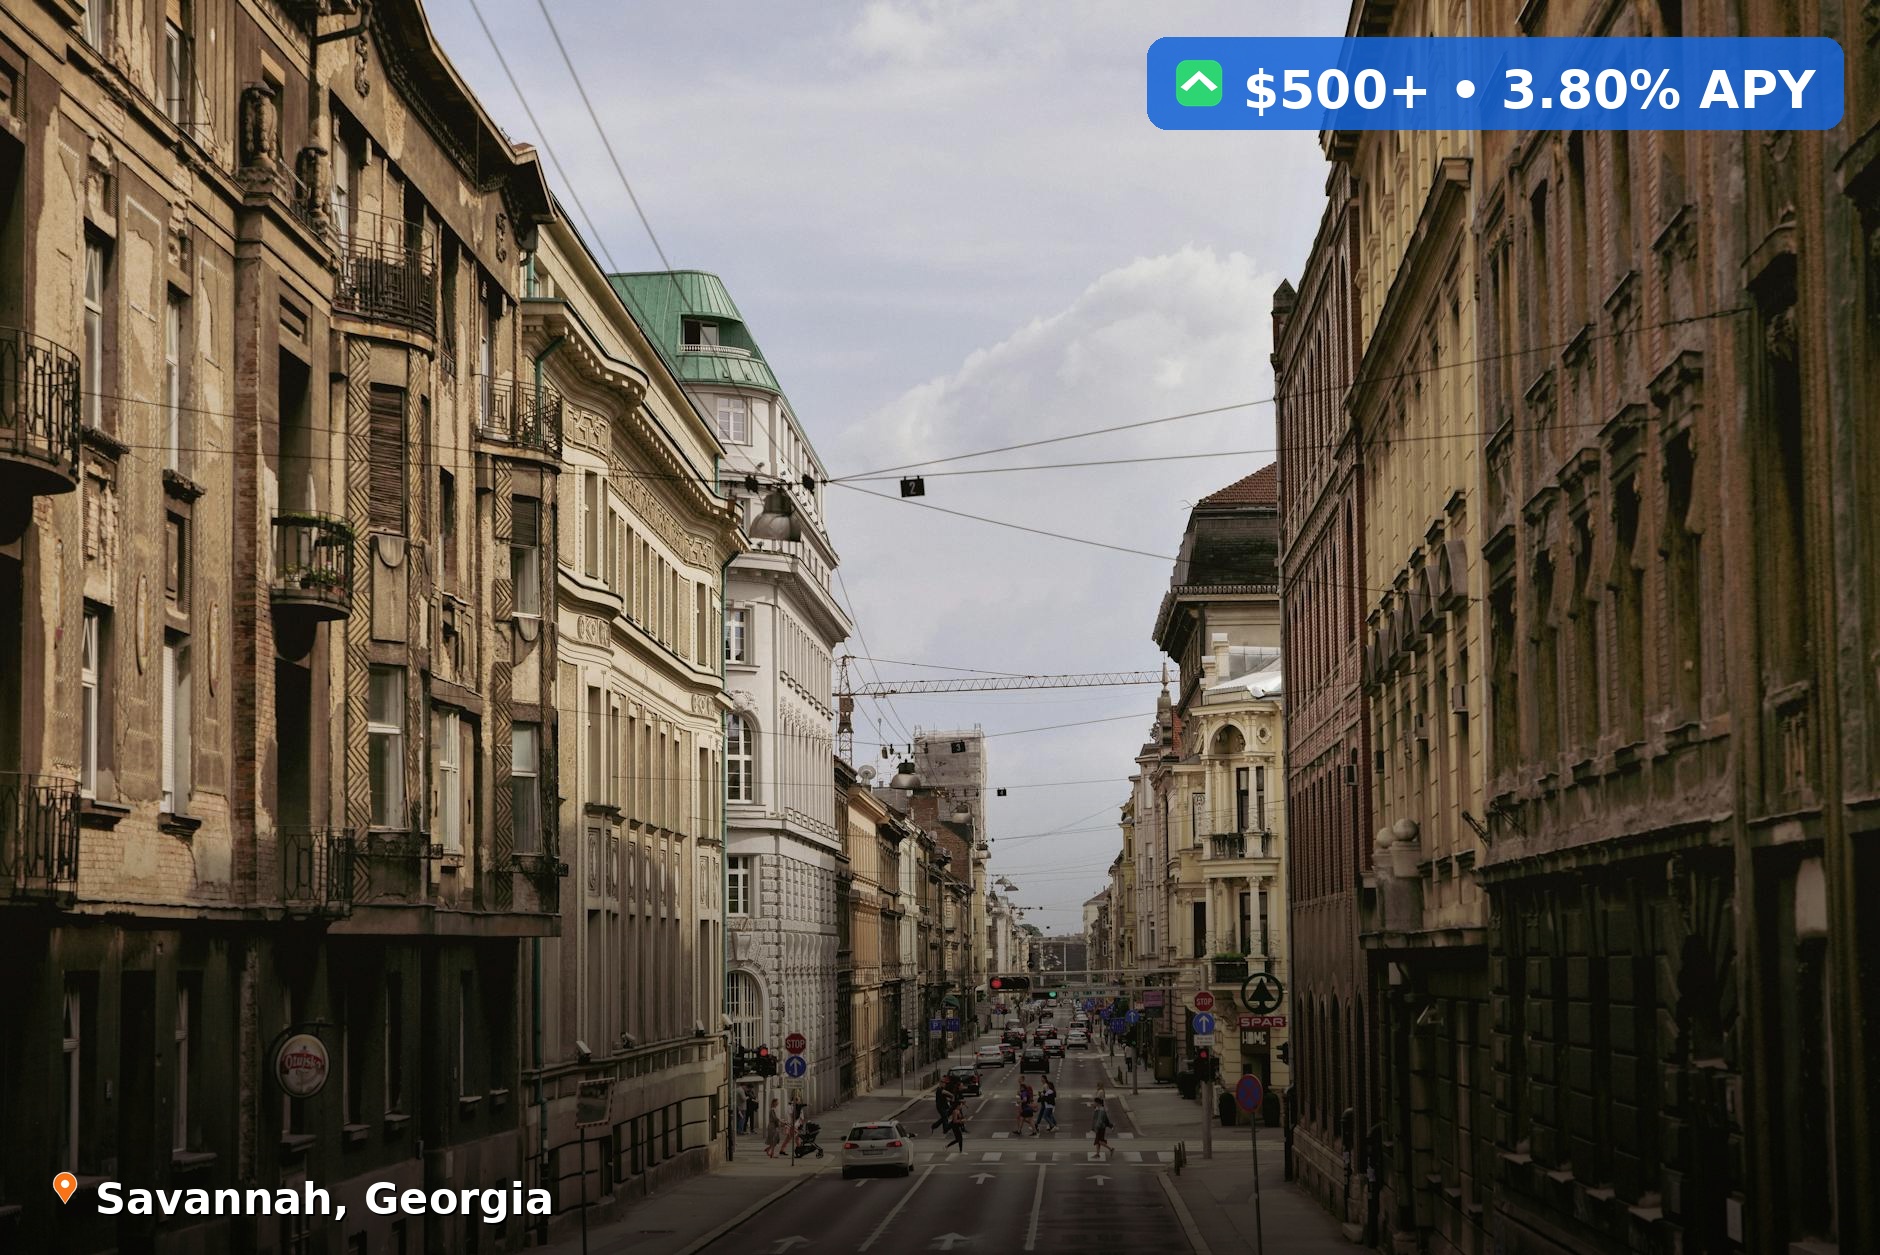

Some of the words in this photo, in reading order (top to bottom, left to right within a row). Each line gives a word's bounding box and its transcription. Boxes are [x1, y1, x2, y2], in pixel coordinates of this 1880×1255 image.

[1196, 998, 1213, 1006] STOP
[1240, 1017, 1285, 1027] SPAR
[786, 1039, 805, 1049] STOP
